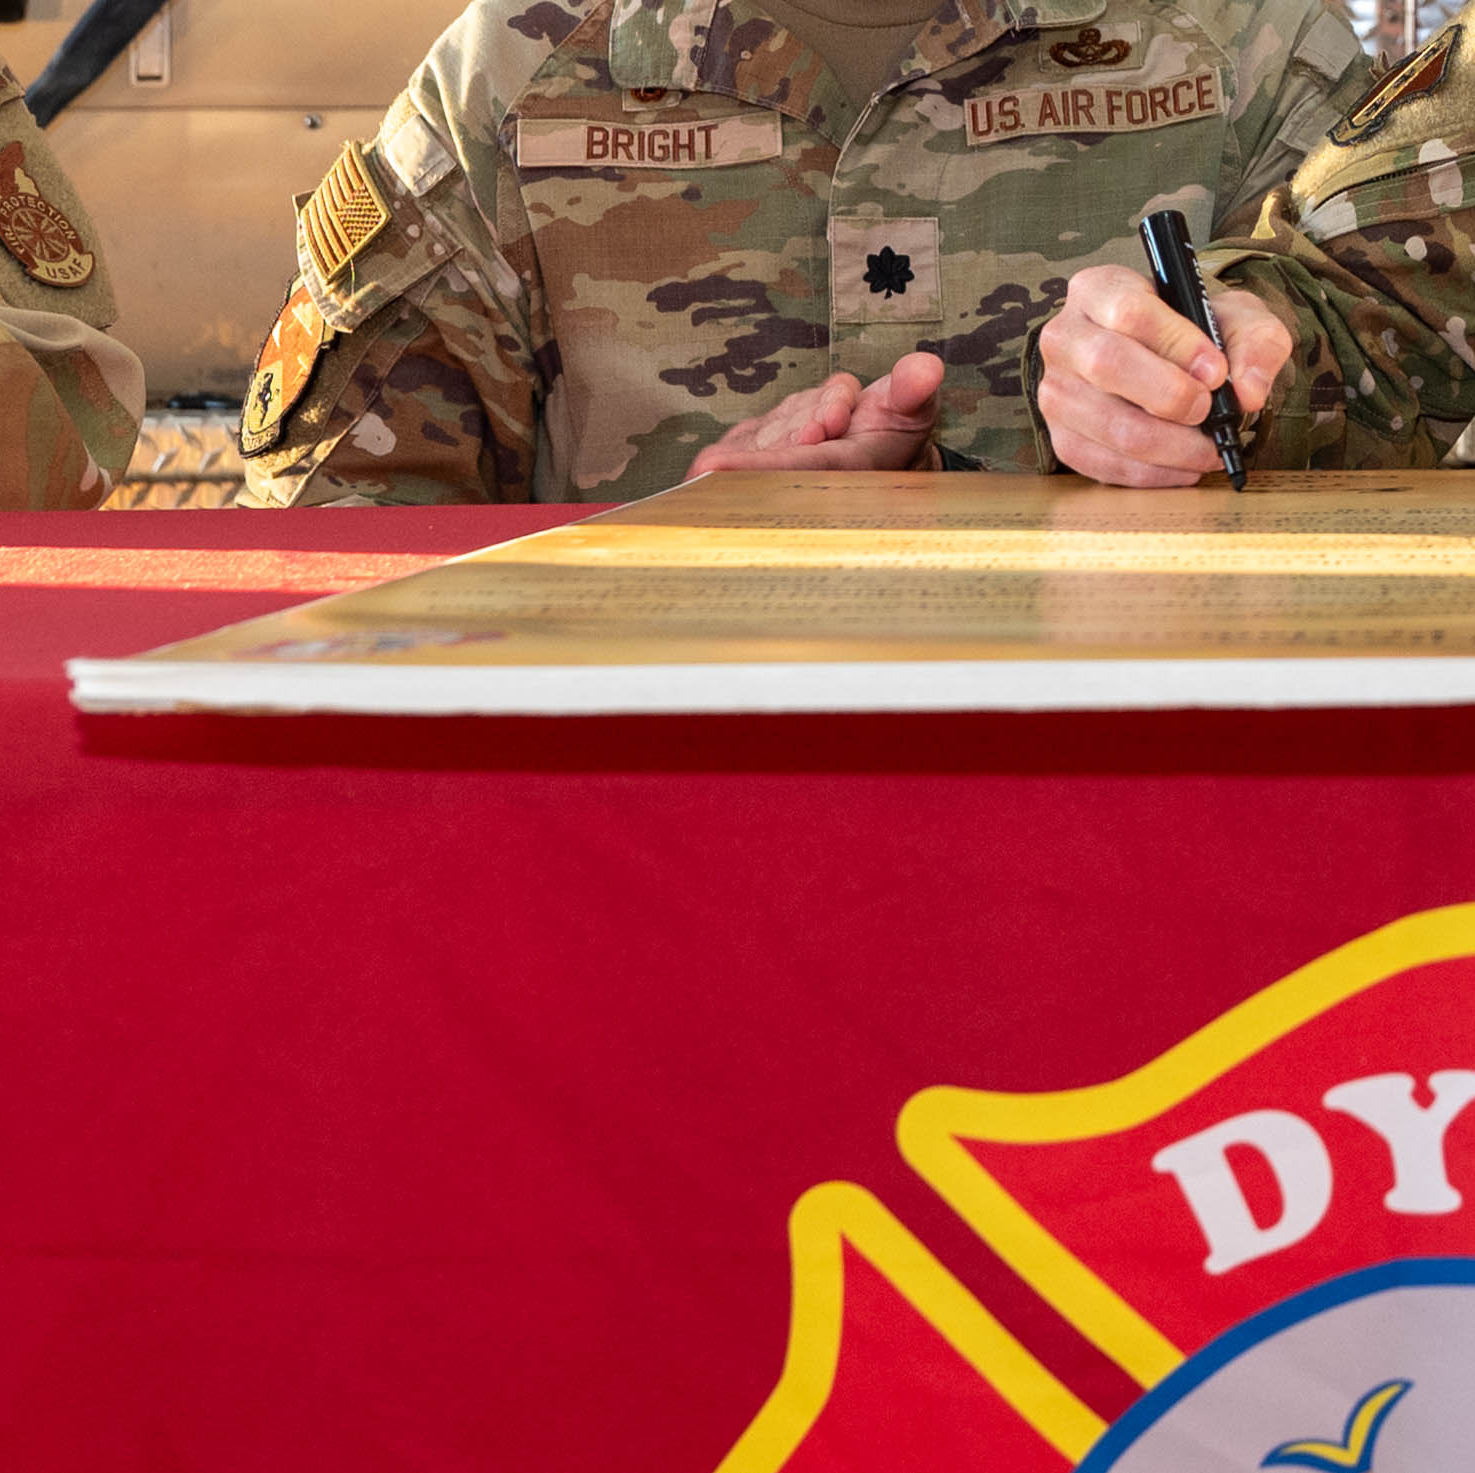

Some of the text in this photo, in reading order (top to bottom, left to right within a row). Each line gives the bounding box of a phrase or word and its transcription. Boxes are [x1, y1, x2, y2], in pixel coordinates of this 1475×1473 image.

[971, 74, 1216, 136] U.S. AIR FORCE
[586, 123, 719, 162] BRIGHT
[0, 195, 77, 240] PROTECTION
[45, 257, 85, 280] USAF
